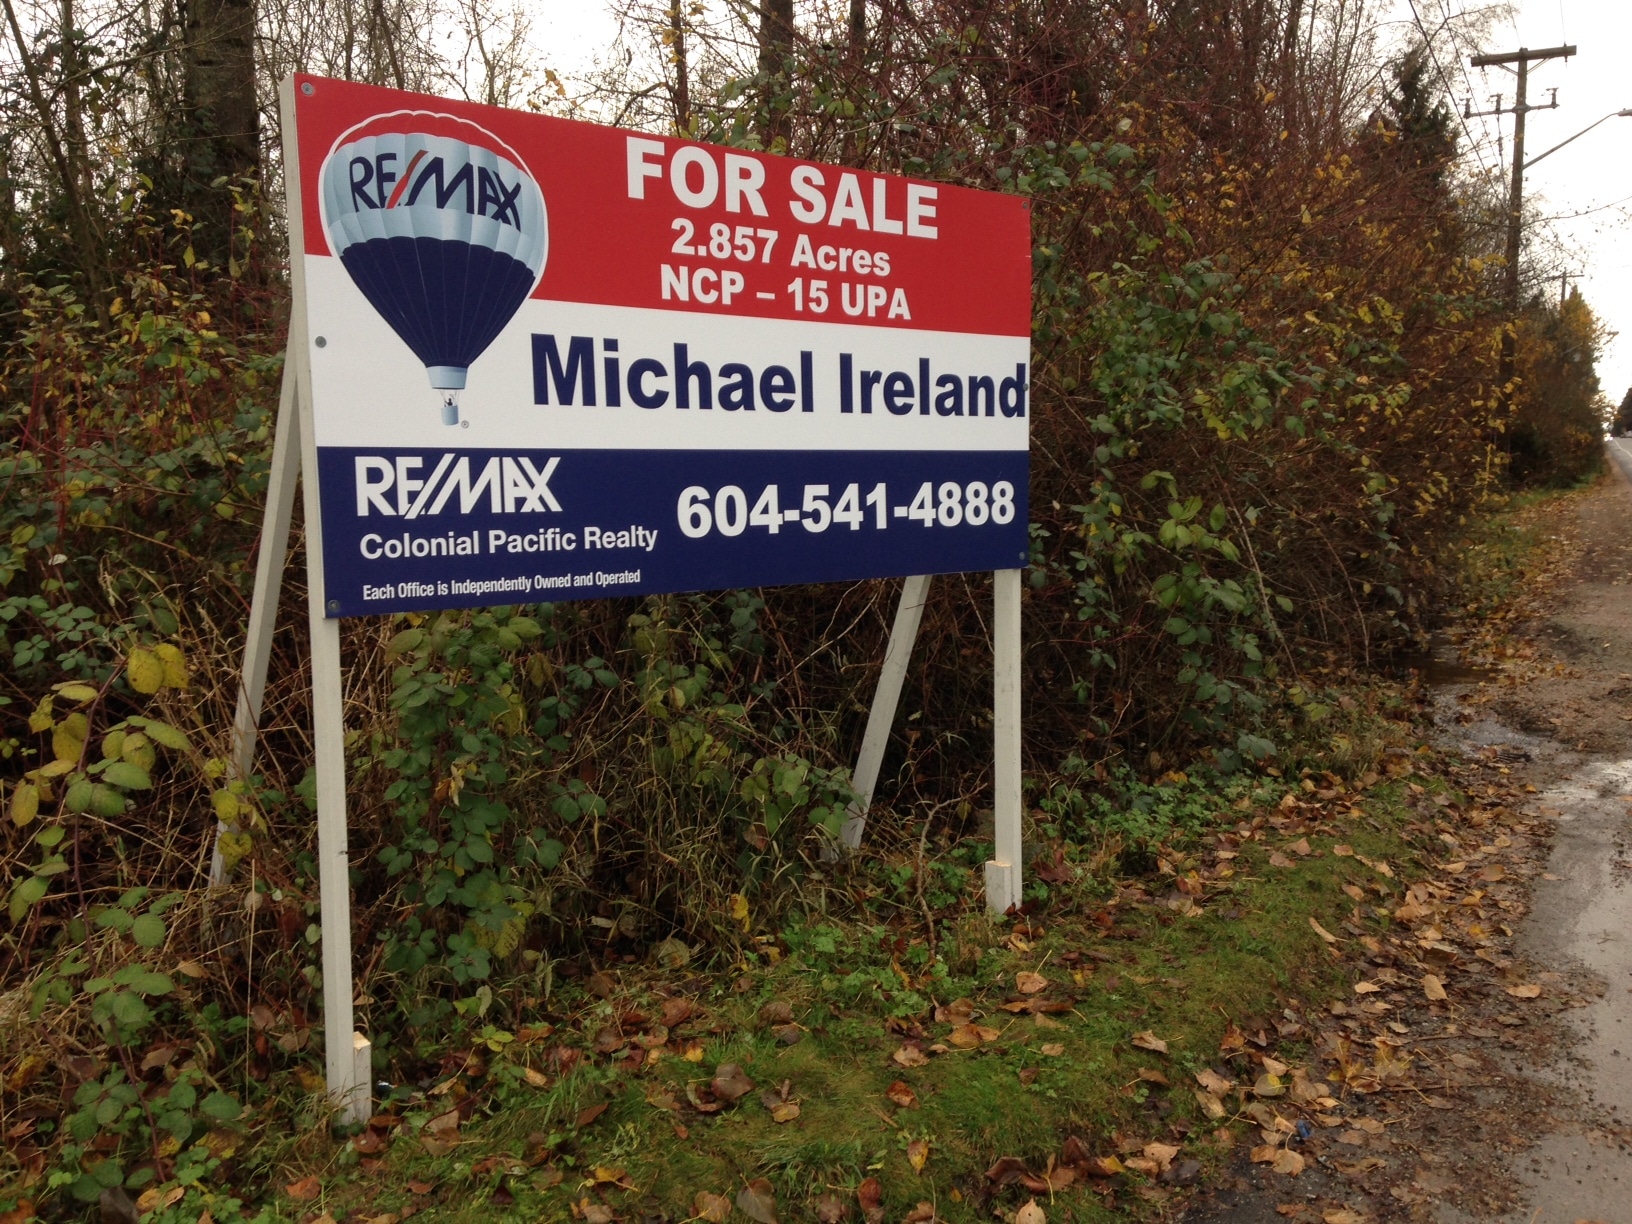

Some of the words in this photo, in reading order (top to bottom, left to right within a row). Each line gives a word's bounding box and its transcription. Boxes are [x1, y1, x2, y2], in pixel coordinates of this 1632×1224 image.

[626, 135, 769, 218] FOR
[789, 164, 939, 240] SALE
[671, 217, 779, 264] 2.857
[790, 233, 892, 277] Acres
[660, 263, 745, 306] NCP
[787, 277, 830, 314] 15
[841, 282, 912, 321] UPA
[531, 332, 814, 413] Michael
[839, 352, 1026, 418] Ireland
[354, 453, 563, 520] RE/MAX
[677, 480, 1016, 539] 604-541-4888
[359, 531, 480, 560] Colonial
[488, 527, 577, 554] Pacific
[583, 525, 658, 552] Realty
[362, 583, 395, 600] Each
[398, 581, 435, 598] Office
[437, 580, 449, 596] is
[451, 575, 532, 596] Independently
[534, 573, 572, 589] Owned
[573, 571, 594, 587] and
[595, 569, 641, 588] Operated
